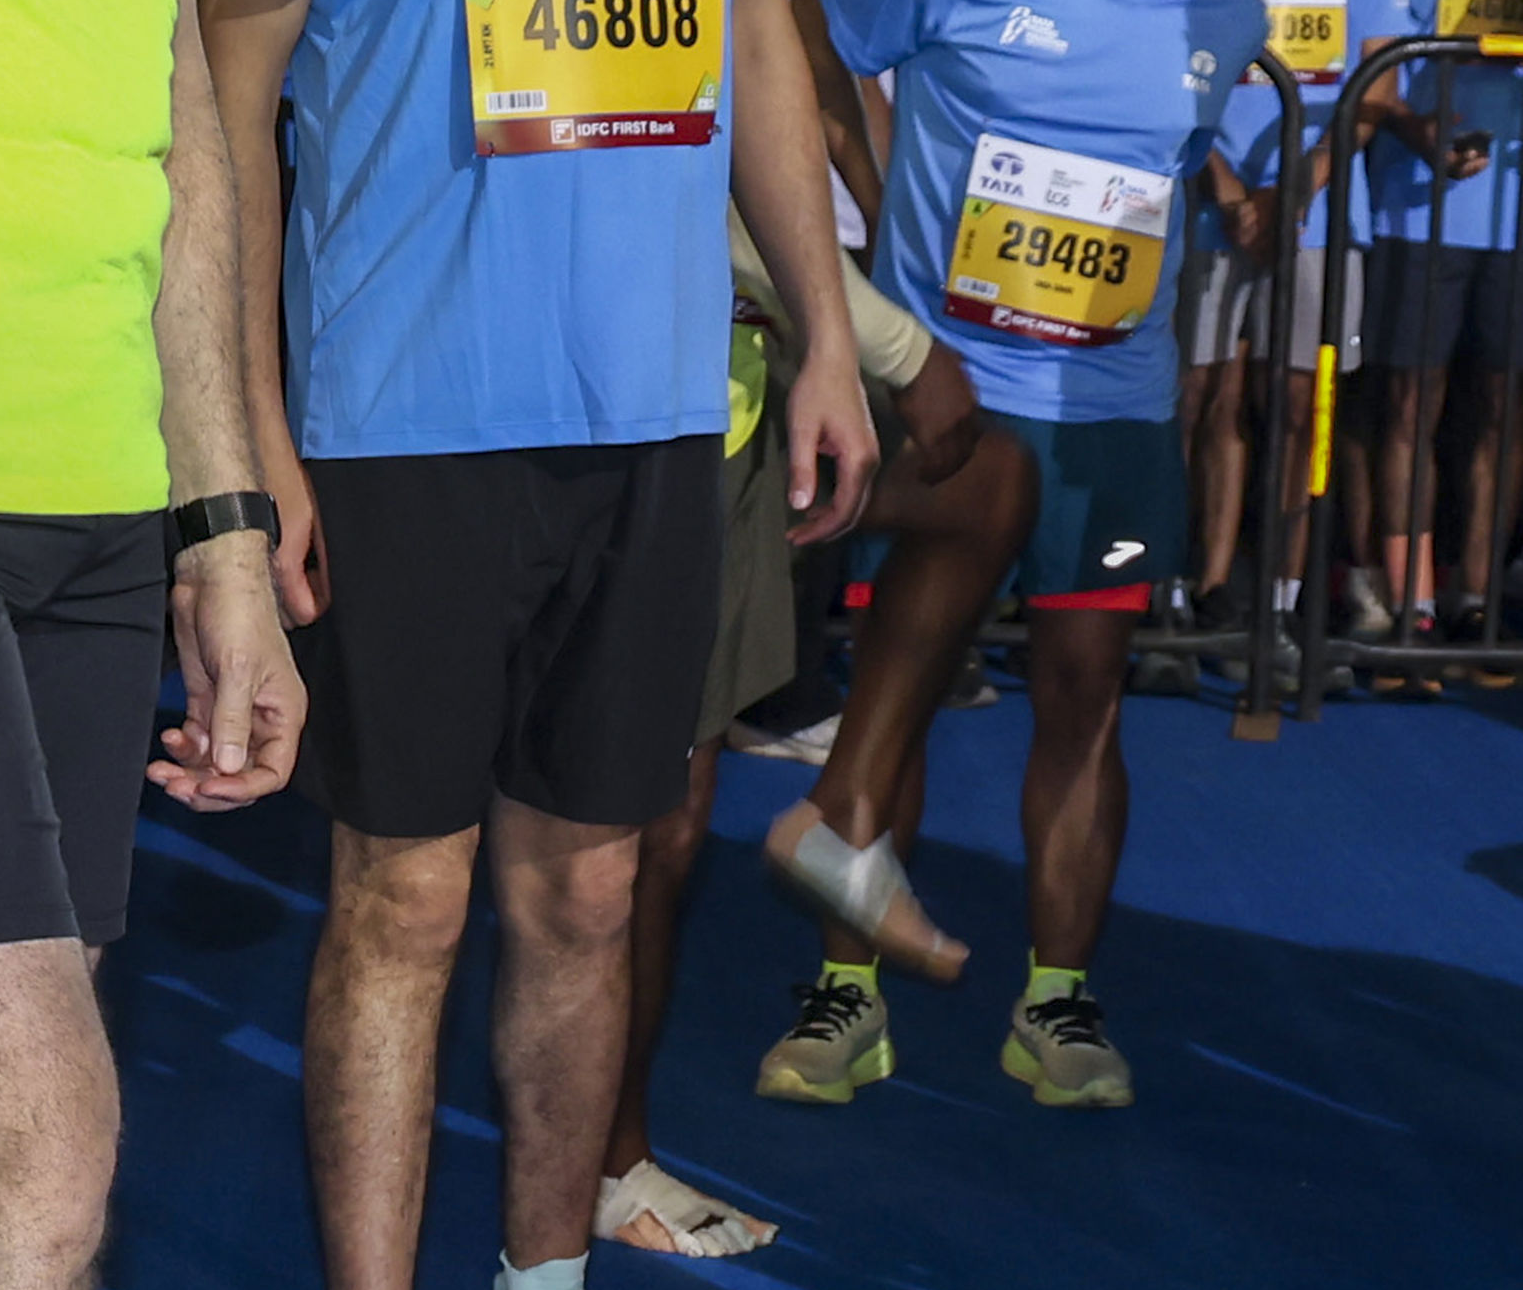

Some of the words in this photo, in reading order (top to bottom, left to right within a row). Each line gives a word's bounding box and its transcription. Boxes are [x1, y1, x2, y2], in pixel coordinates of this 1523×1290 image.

[1270, 13, 1333, 41] 086
[577, 122, 610, 137] IDFC
[612, 120, 648, 136] FIRST
[649, 120, 675, 135] Bank
[980, 175, 1025, 197] TATA
[998, 219, 1131, 285] 29483
[1036, 319, 1067, 336] FIRST
